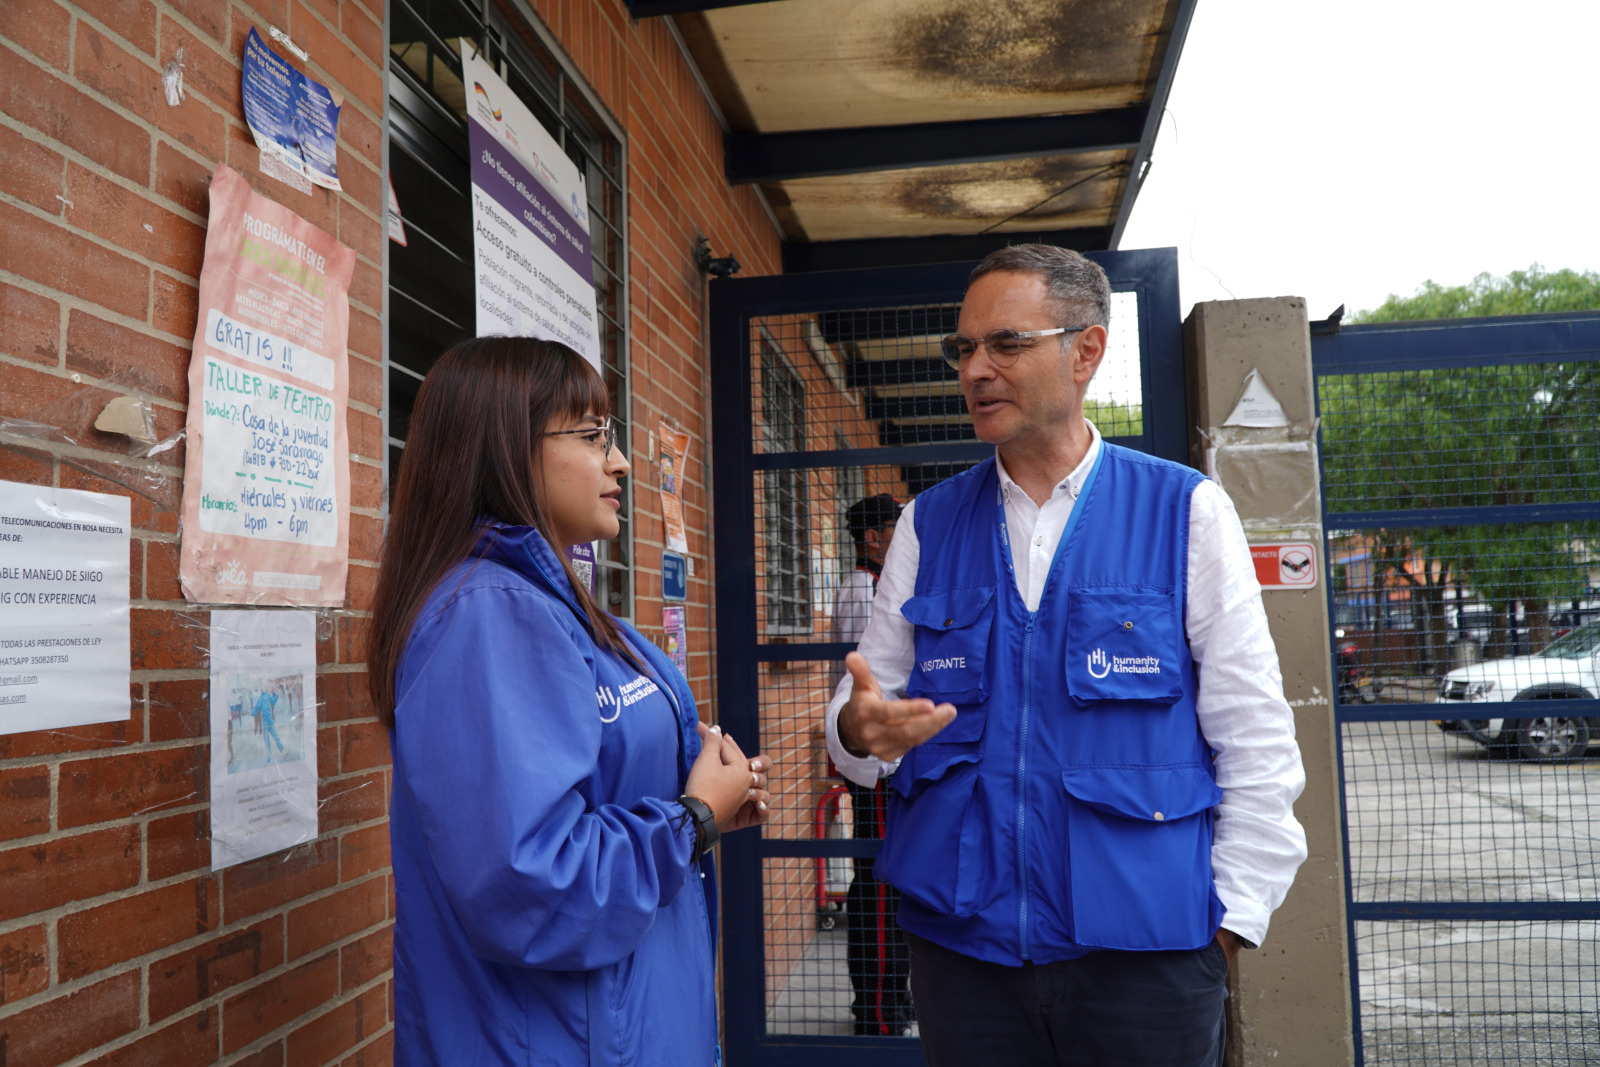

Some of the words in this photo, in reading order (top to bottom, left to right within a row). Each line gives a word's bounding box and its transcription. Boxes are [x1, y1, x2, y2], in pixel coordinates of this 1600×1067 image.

[258, 47, 290, 76] movemos
[265, 61, 292, 88] talento
[496, 160, 516, 188] tienes
[474, 193, 484, 211] Te
[476, 219, 504, 251] Acceso
[505, 245, 533, 274] gratuito
[317, 254, 326, 275] EL
[216, 318, 273, 361] GRATIS
[208, 361, 263, 397] TALLER
[269, 383, 280, 400] DE
[284, 386, 332, 422] TEATRO
[268, 415, 279, 436] de
[281, 419, 289, 437] la
[293, 423, 329, 449] juventud
[252, 432, 276, 453] José
[279, 439, 324, 468] Saramago
[291, 496, 297, 513] y
[1, 516, 72, 530] TELECOMUNICACIONES
[83, 524, 97, 532] BOSA
[98, 526, 123, 535] NECESITA
[244, 512, 268, 535] 4pm
[289, 514, 309, 538] 6pm
[12, 534, 23, 542] DE:
[22, 568, 63, 581] MANEJO
[65, 570, 77, 581] DE
[80, 571, 103, 582] SIIGO
[14, 592, 36, 604] CON
[38, 593, 97, 605] EXPERIENCIA
[1, 640, 22, 649] TODAS
[24, 639, 36, 648] LAS
[37, 638, 82, 647] PRESTACIONES
[82, 638, 91, 646] DE
[91, 638, 102, 646] LEY
[31, 655, 69, 665] 3508287350
[920, 656, 966, 673] VISITANTE
[1113, 655, 1160, 668] humanity
[1113, 664, 1160, 674] &inclusion
